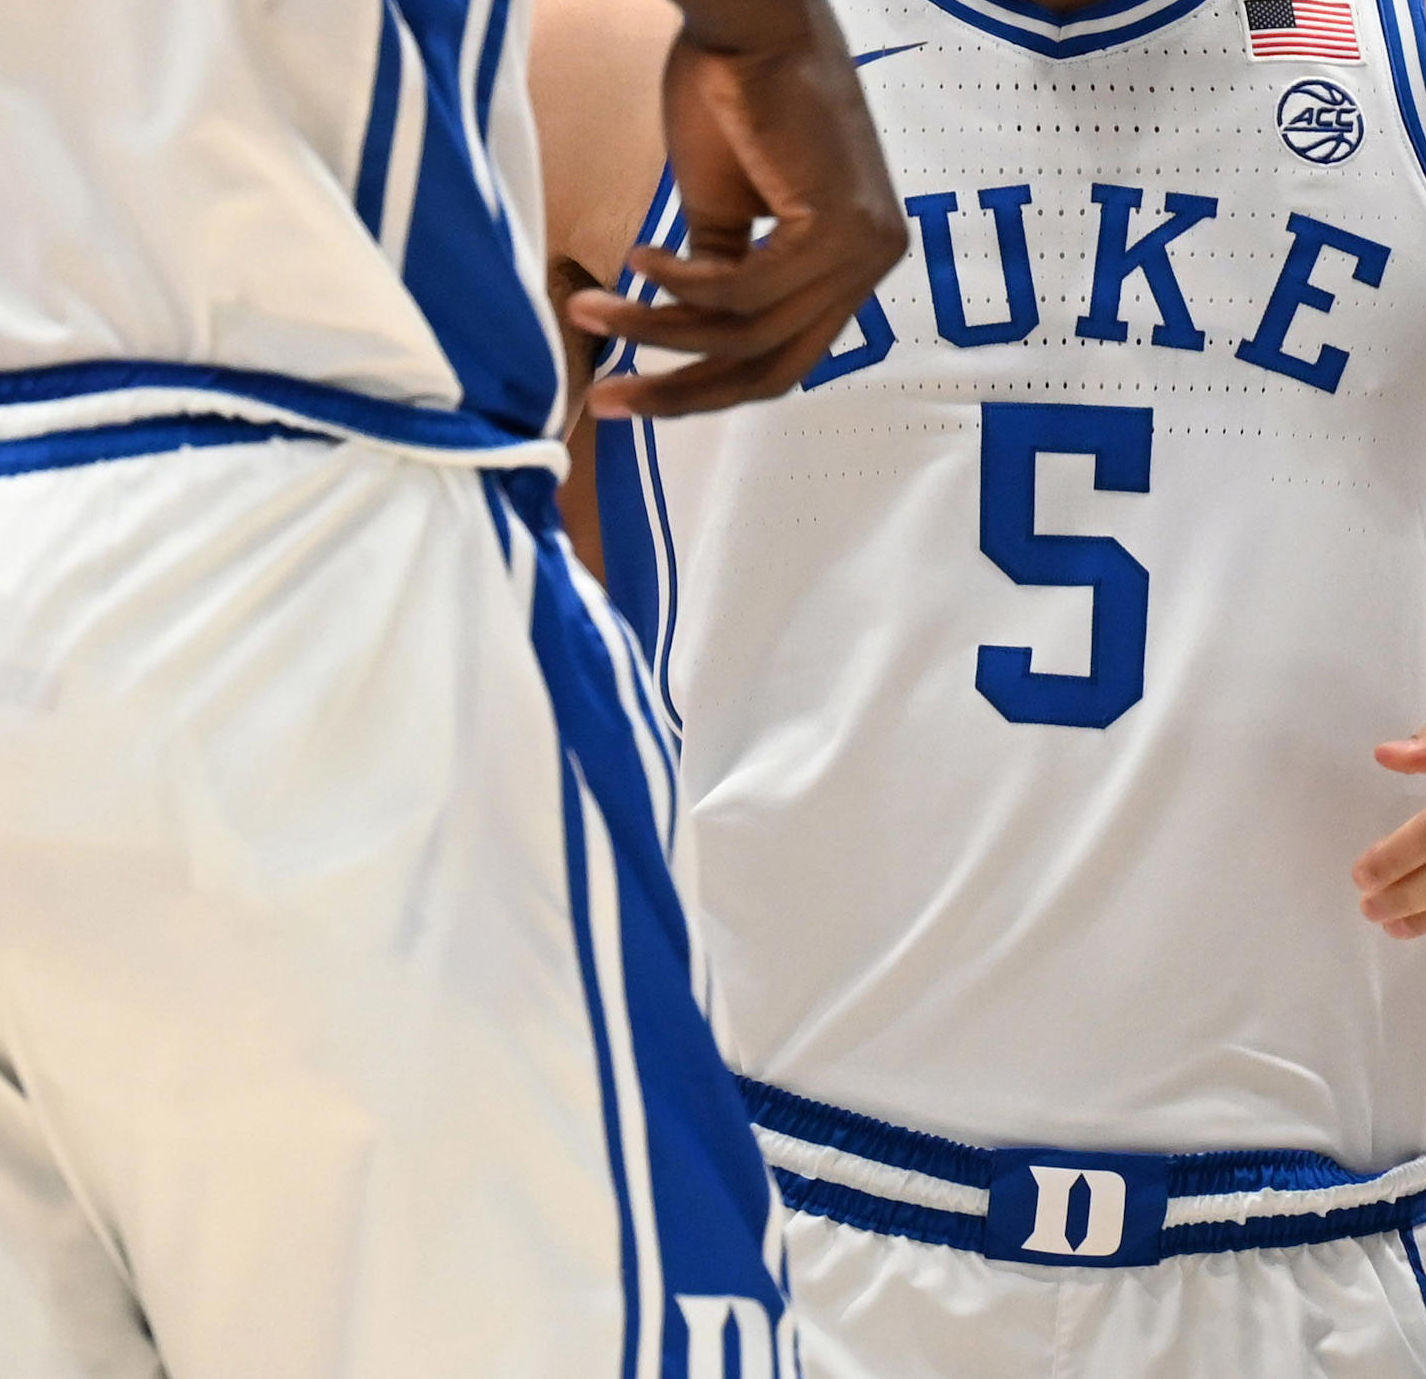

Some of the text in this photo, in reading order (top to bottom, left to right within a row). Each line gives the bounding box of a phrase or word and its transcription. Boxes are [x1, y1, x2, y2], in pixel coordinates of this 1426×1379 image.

[1288, 107, 1358, 127] ACC
[975, 401, 1154, 730] 5
[1021, 1165, 1127, 1257] D
